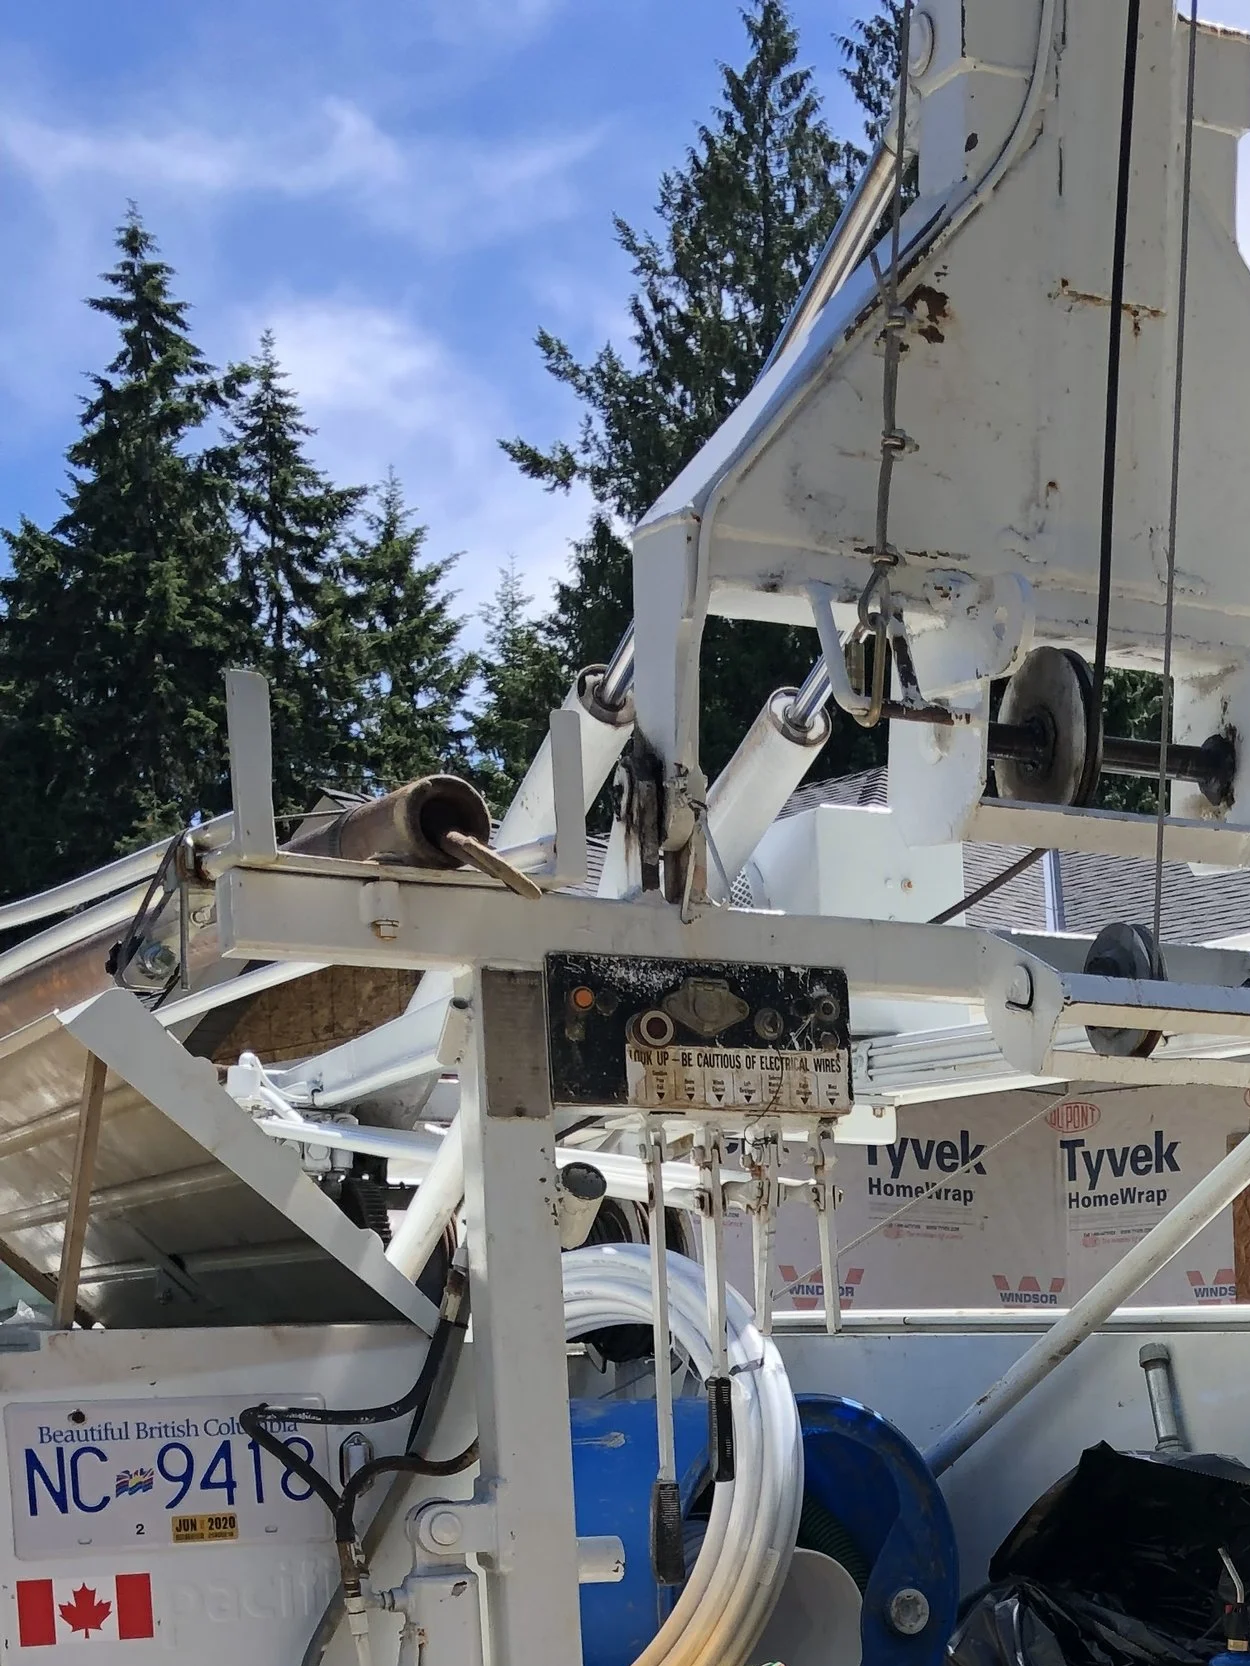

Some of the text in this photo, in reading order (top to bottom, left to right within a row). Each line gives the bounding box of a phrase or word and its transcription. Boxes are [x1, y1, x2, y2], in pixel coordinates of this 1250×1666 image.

[656, 1051, 669, 1066] UP
[681, 1052, 693, 1067] BE
[697, 1053, 741, 1069] CAUTIOUS
[745, 1055, 757, 1070] OF
[760, 1055, 810, 1072] ELECTRICAL
[813, 1057, 842, 1073] WIRES
[1060, 1130, 1181, 1191] Tyvek
[868, 1177, 974, 1206] HomeWrap
[1068, 1187, 1168, 1210] HomeWrap
[789, 1284, 855, 1297] WINDOR
[999, 1292, 1058, 1305] WINDSOR
[1193, 1285, 1236, 1298] WINDS
[39, 1420, 130, 1444] Beautiful
[136, 1418, 200, 1440] British
[203, 1414, 299, 1438] Colubia
[24, 1436, 316, 1516] NC 9418
[135, 1523, 146, 1535] 2
[175, 1516, 236, 1532] JUN 2020
